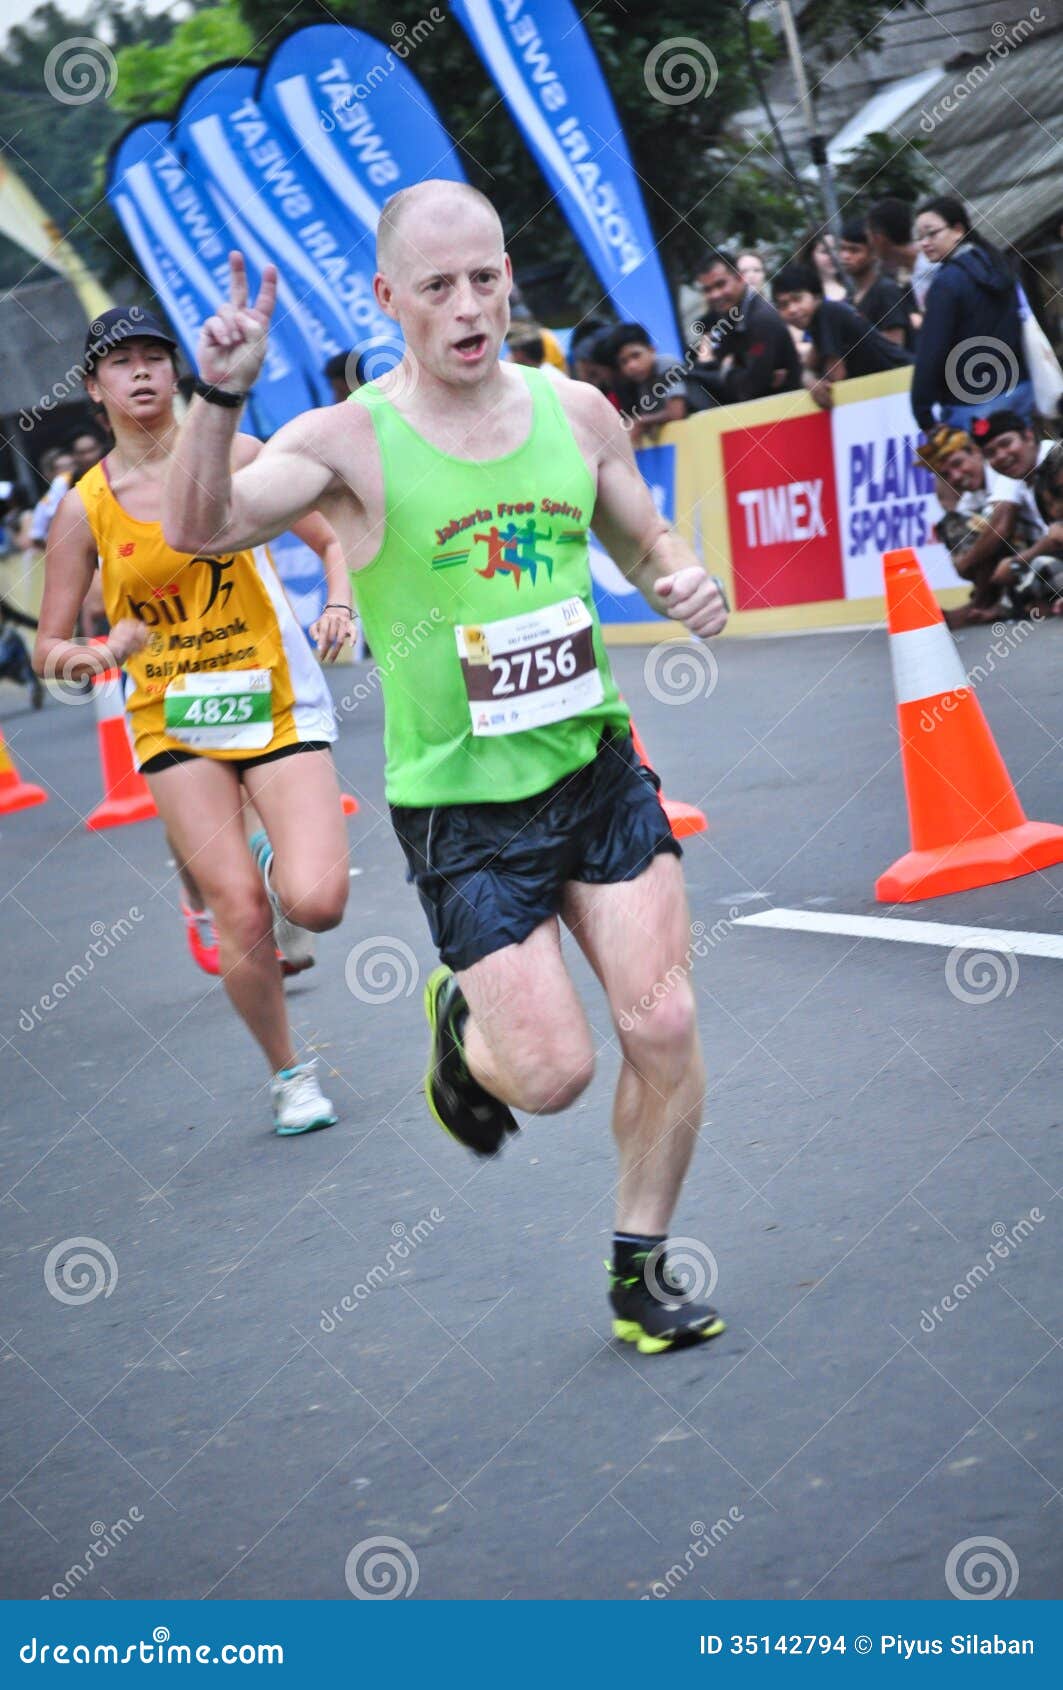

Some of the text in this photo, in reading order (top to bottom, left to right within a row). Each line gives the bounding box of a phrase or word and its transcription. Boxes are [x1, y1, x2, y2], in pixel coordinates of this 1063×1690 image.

[849, 432, 936, 507] PLAN
[434, 498, 582, 546] Jakarta Free Spirit
[736, 478, 828, 549] TIMEX
[849, 500, 927, 557] SPORTS
[168, 617, 247, 651] Maybank
[145, 645, 257, 679] Bali Marathon
[488, 639, 577, 697] 2756
[184, 696, 253, 725] 4825
